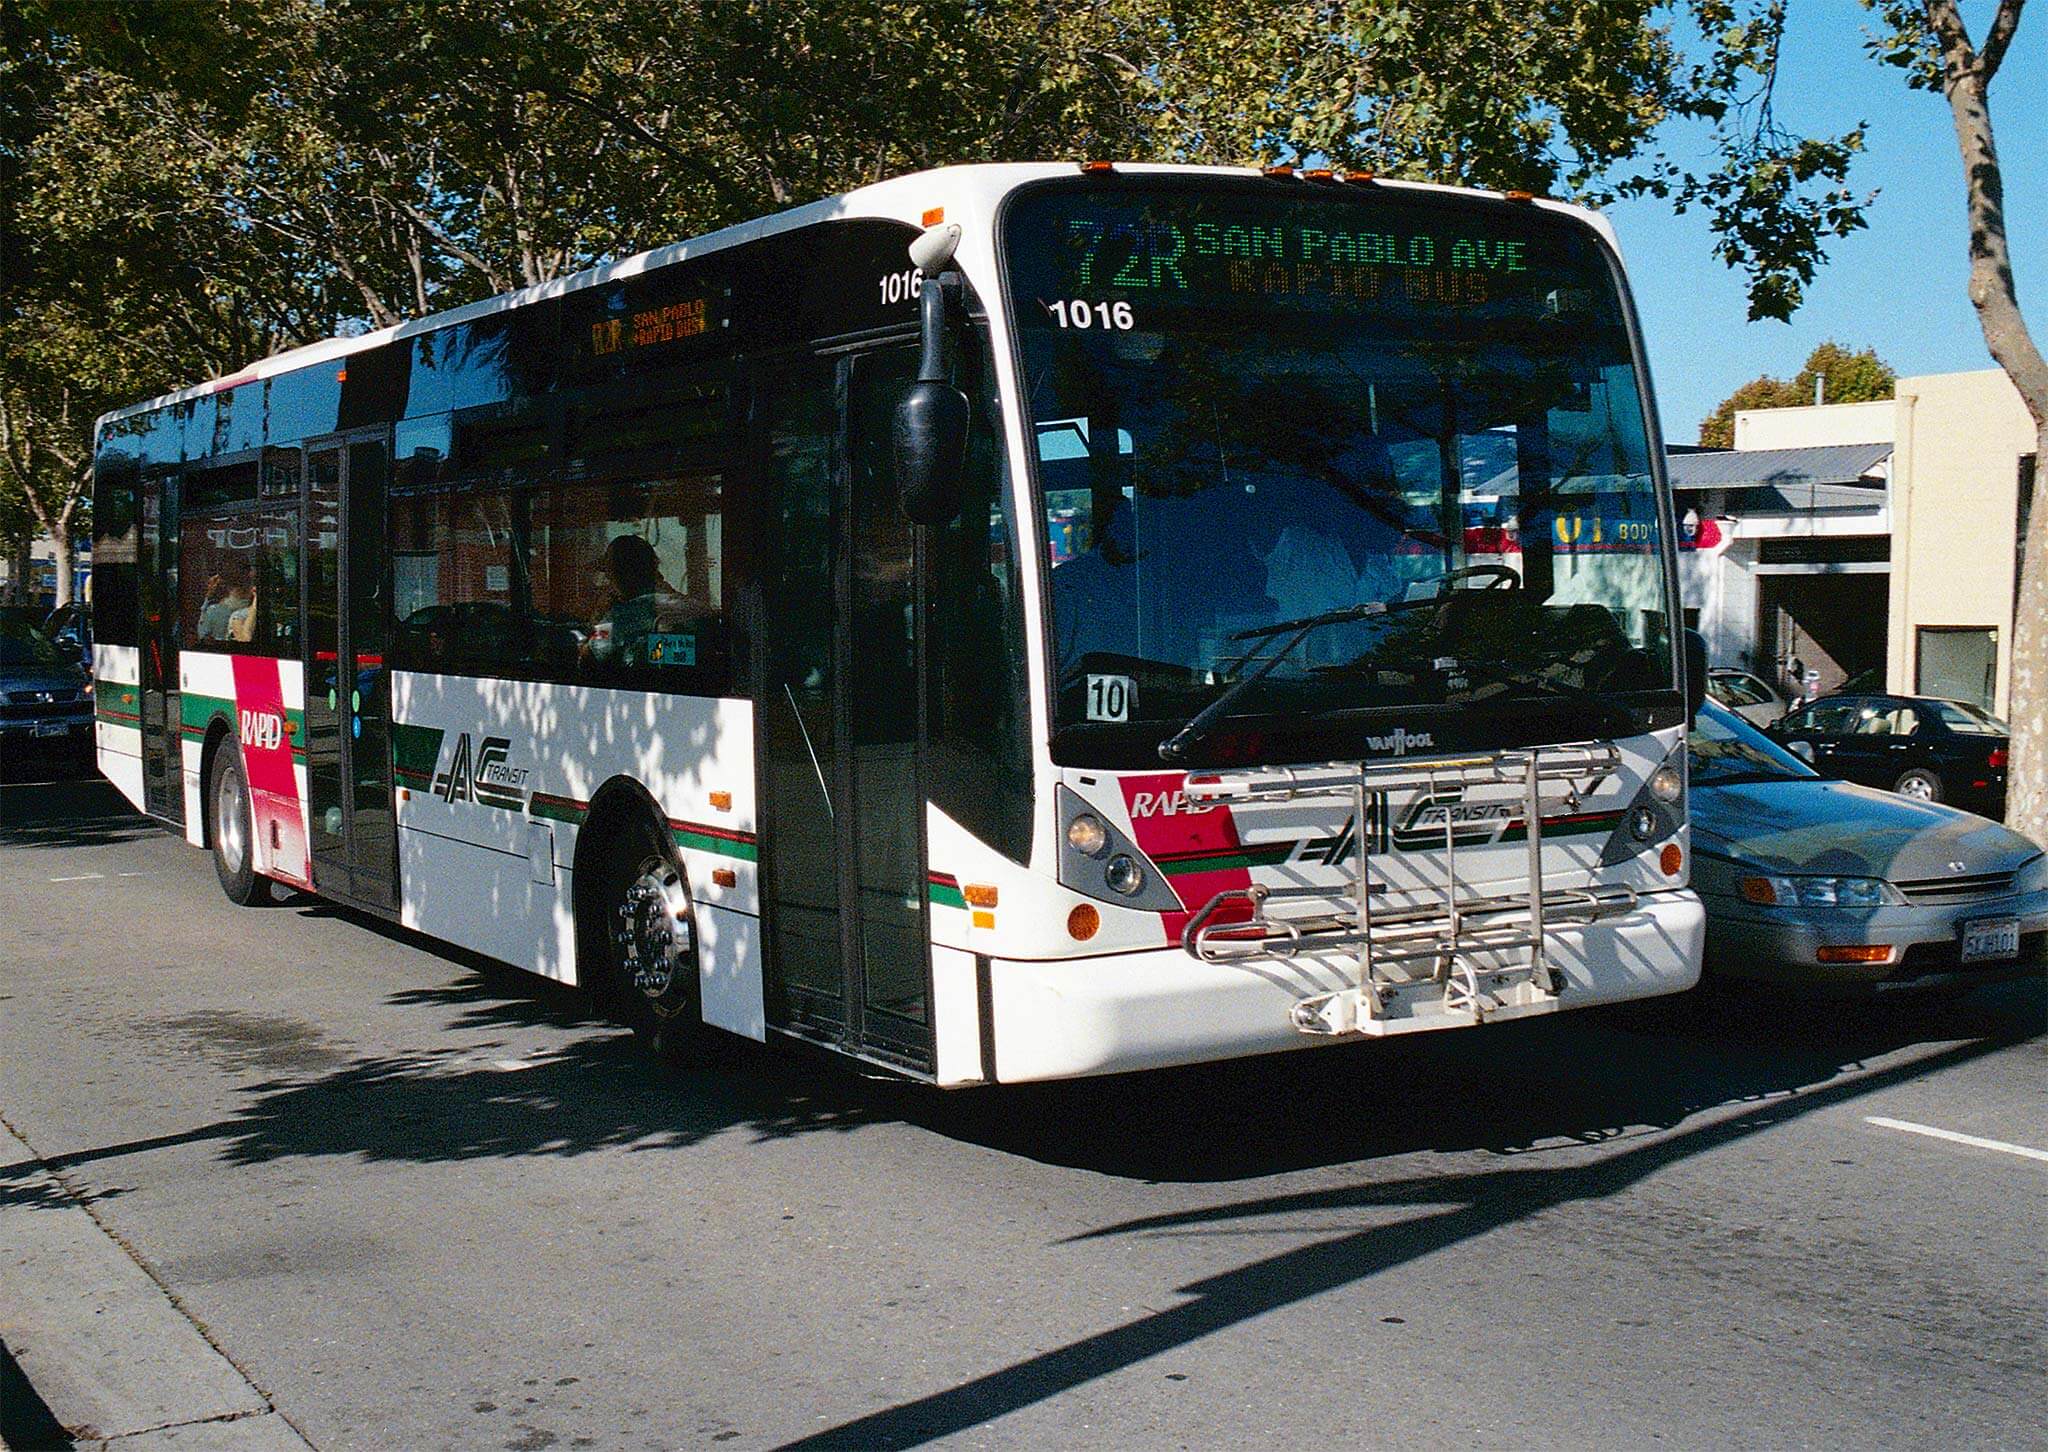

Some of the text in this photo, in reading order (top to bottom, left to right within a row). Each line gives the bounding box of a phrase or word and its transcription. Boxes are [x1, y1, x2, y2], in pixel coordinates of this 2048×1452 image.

[1069, 220, 1527, 288] 72R SAN PABLO AVE
[880, 267, 923, 304] 1016
[1230, 259, 1488, 303] RAPID BUS
[1050, 300, 1134, 330] 1016
[1092, 678, 1124, 717] 10
[241, 709, 281, 750] RAPID
[433, 732, 525, 813] AC
[486, 763, 529, 786] TRANSIT
[1423, 803, 1505, 824] TRANSIT
